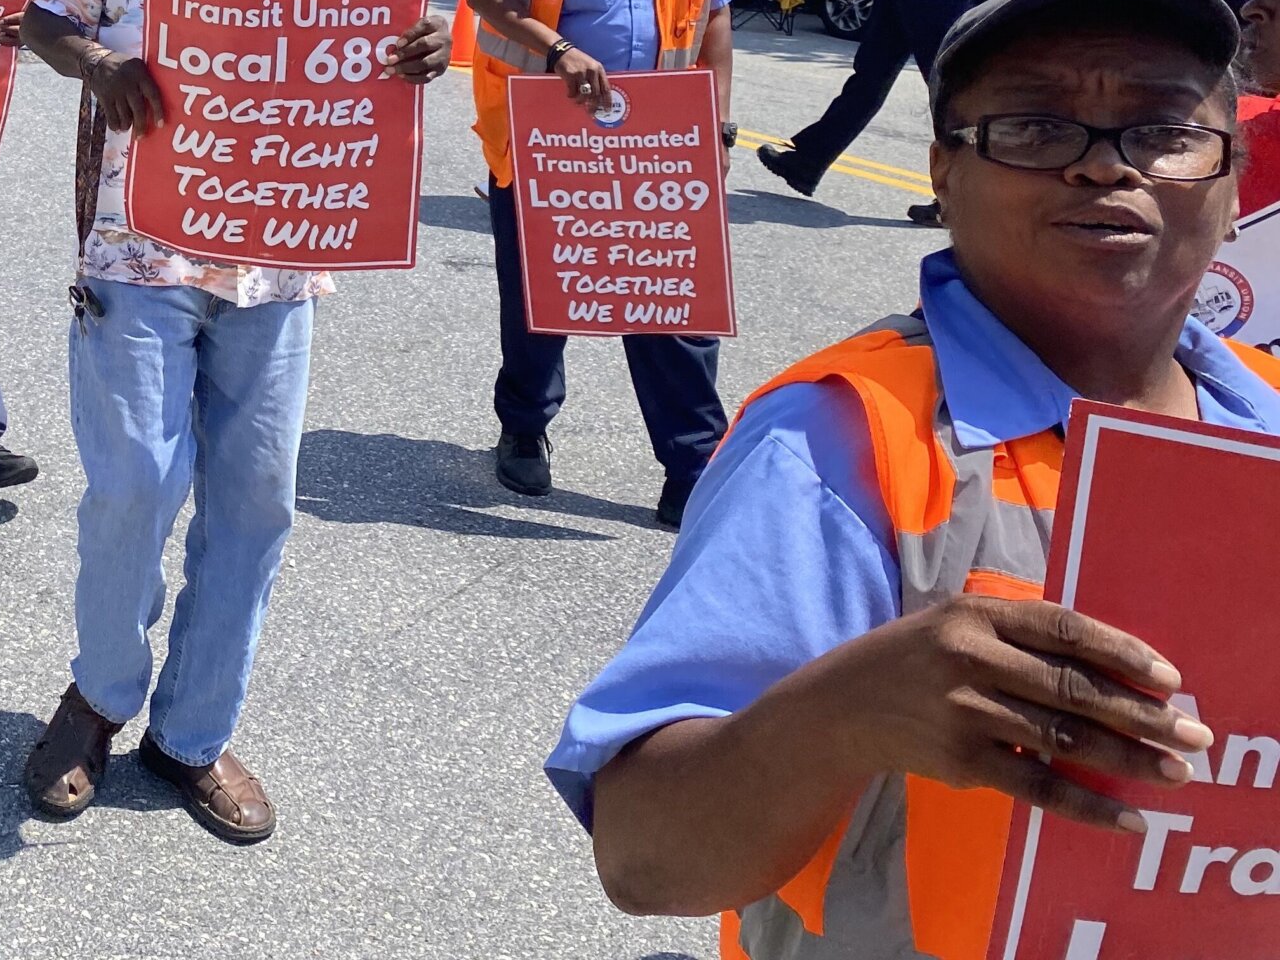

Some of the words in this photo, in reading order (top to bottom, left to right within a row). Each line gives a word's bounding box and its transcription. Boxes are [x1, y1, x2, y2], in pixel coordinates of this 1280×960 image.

[158, 23, 287, 82] Local
[180, 84, 374, 126] TOGETHER
[172, 124, 237, 162] WE
[251, 134, 379, 168] FIGHT!
[528, 126, 700, 153] Amalgamated
[532, 153, 615, 174] Transit
[620, 155, 692, 174] Union
[174, 165, 369, 209] TOGETHER
[529, 179, 623, 210] Local
[634, 180, 709, 211] 689
[181, 207, 248, 242] WE
[263, 217, 357, 250] WIN!
[552, 215, 691, 240] TOGETHER
[553, 243, 598, 264] WE
[608, 244, 696, 268] FIGHT!
[557, 271, 696, 297] TOGETHER
[1210, 263, 1245, 285] ANSIT
[1239, 289, 1250, 319] UNION
[568, 300, 613, 322] WE
[625, 302, 689, 325] WIN!
